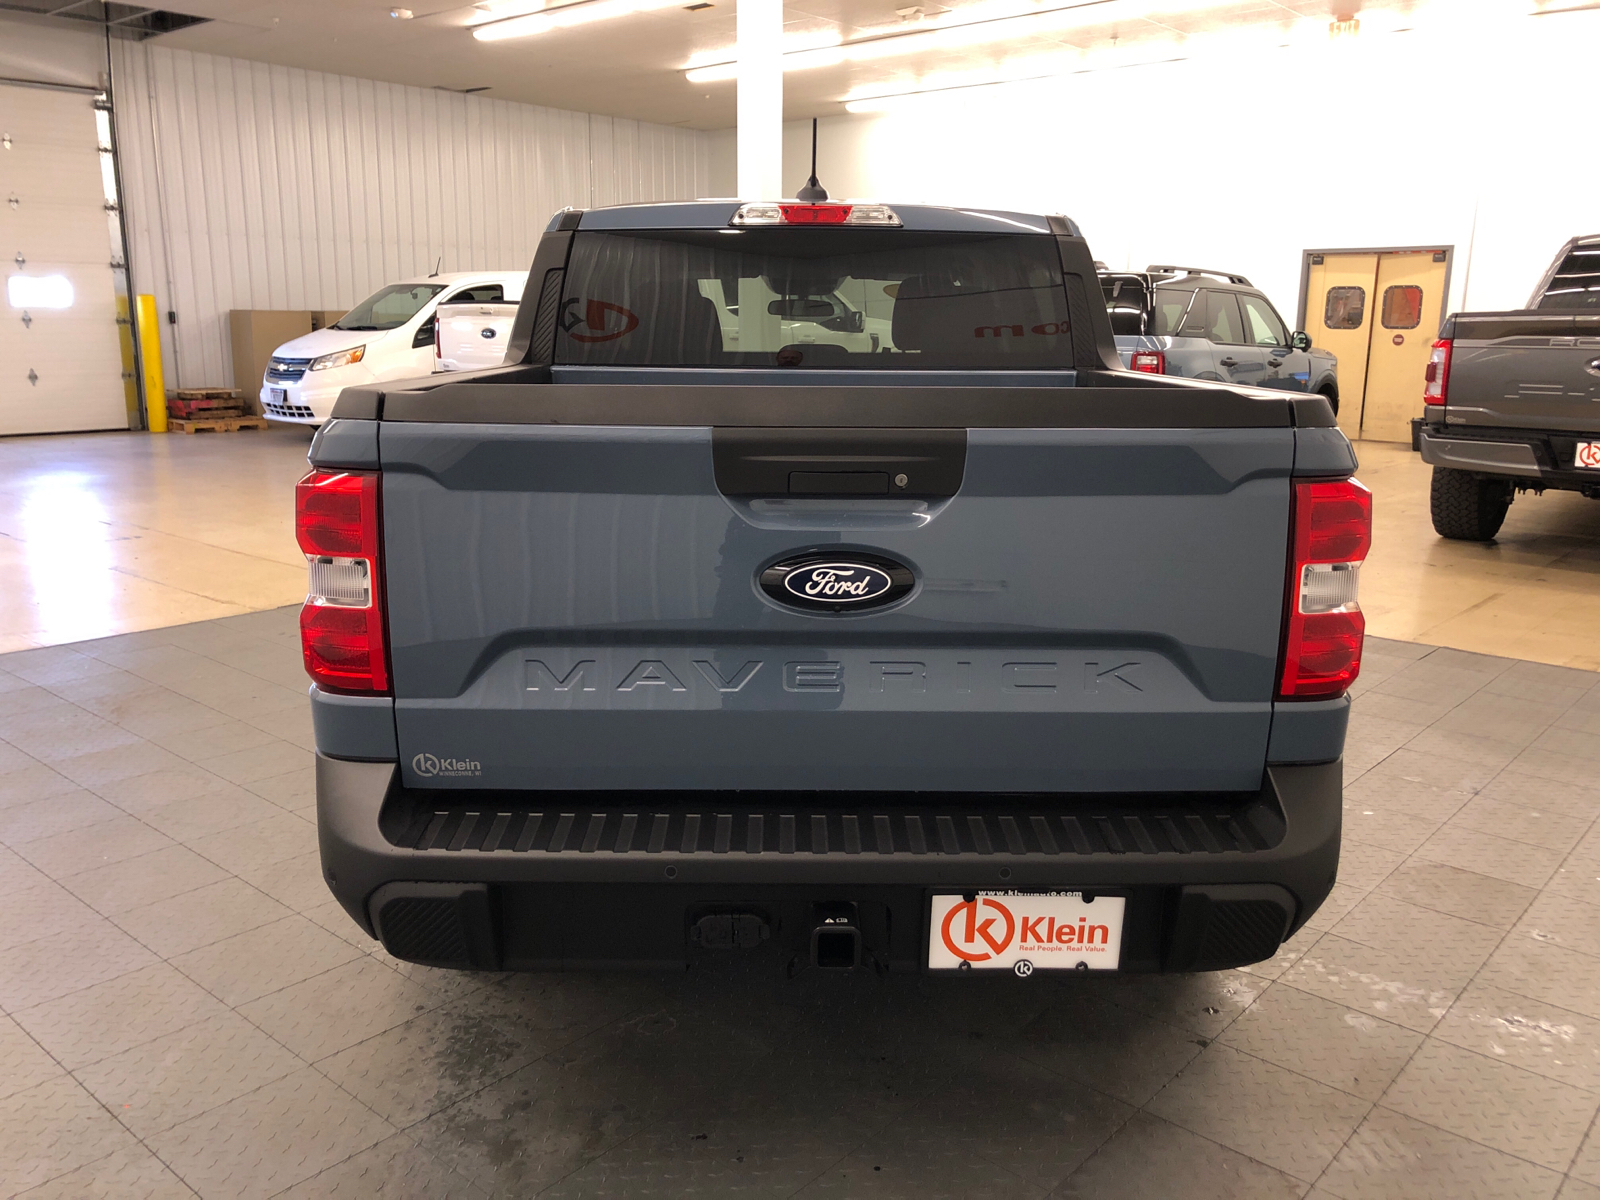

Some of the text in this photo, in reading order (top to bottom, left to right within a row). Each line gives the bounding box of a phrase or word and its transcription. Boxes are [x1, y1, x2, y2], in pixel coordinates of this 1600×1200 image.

[805, 568, 871, 595] Ford
[523, 659, 1144, 693] MAVERICK
[440, 758, 481, 771] Klein
[1019, 916, 1109, 945] Klein
[1037, 945, 1064, 953] People.
